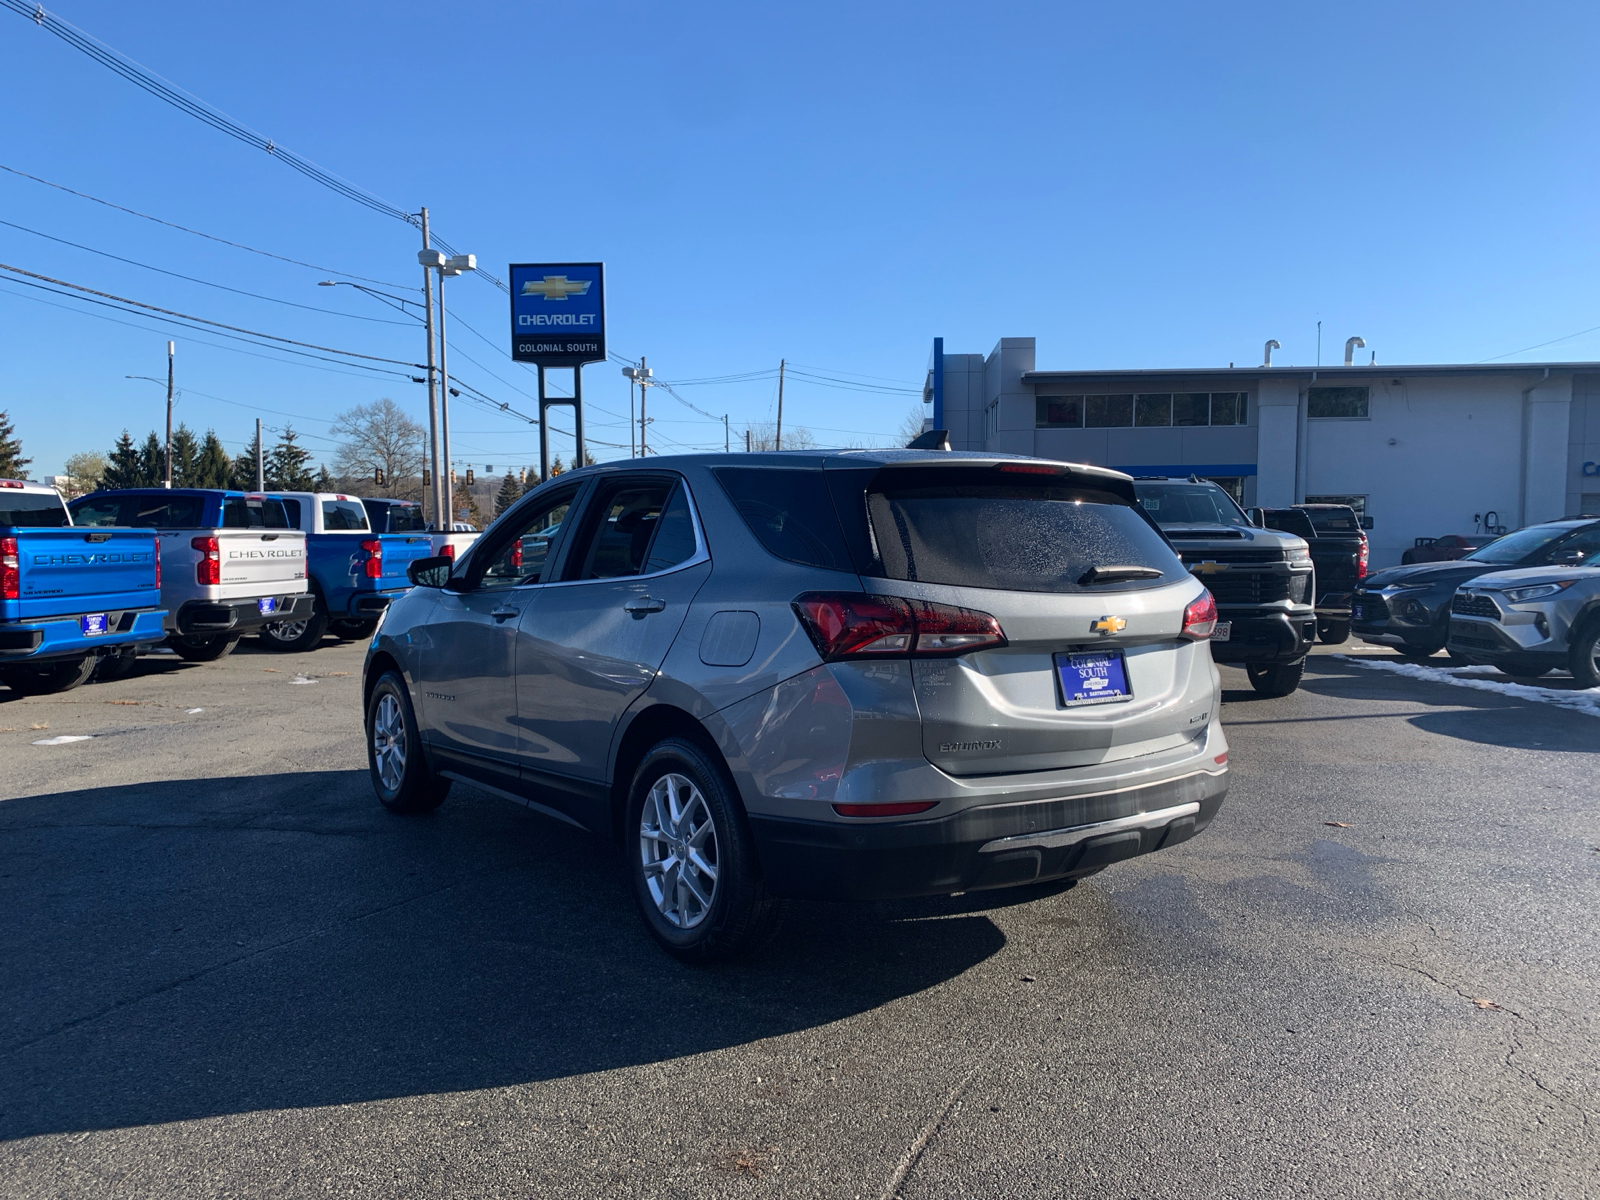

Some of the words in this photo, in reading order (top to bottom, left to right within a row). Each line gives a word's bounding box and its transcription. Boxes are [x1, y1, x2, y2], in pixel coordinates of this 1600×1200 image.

[518, 314, 596, 326] CHEVROLET
[519, 344, 564, 352] COLONIAL
[566, 344, 597, 352] SOUTH
[1145, 501, 1158, 509] 585
[34, 552, 153, 566] CHEVROLET
[229, 549, 303, 559] CHEVROLET
[1071, 658, 1111, 669] COLONIAL
[1079, 667, 1108, 678] SOUTH
[939, 740, 1001, 753] EQUINOX
